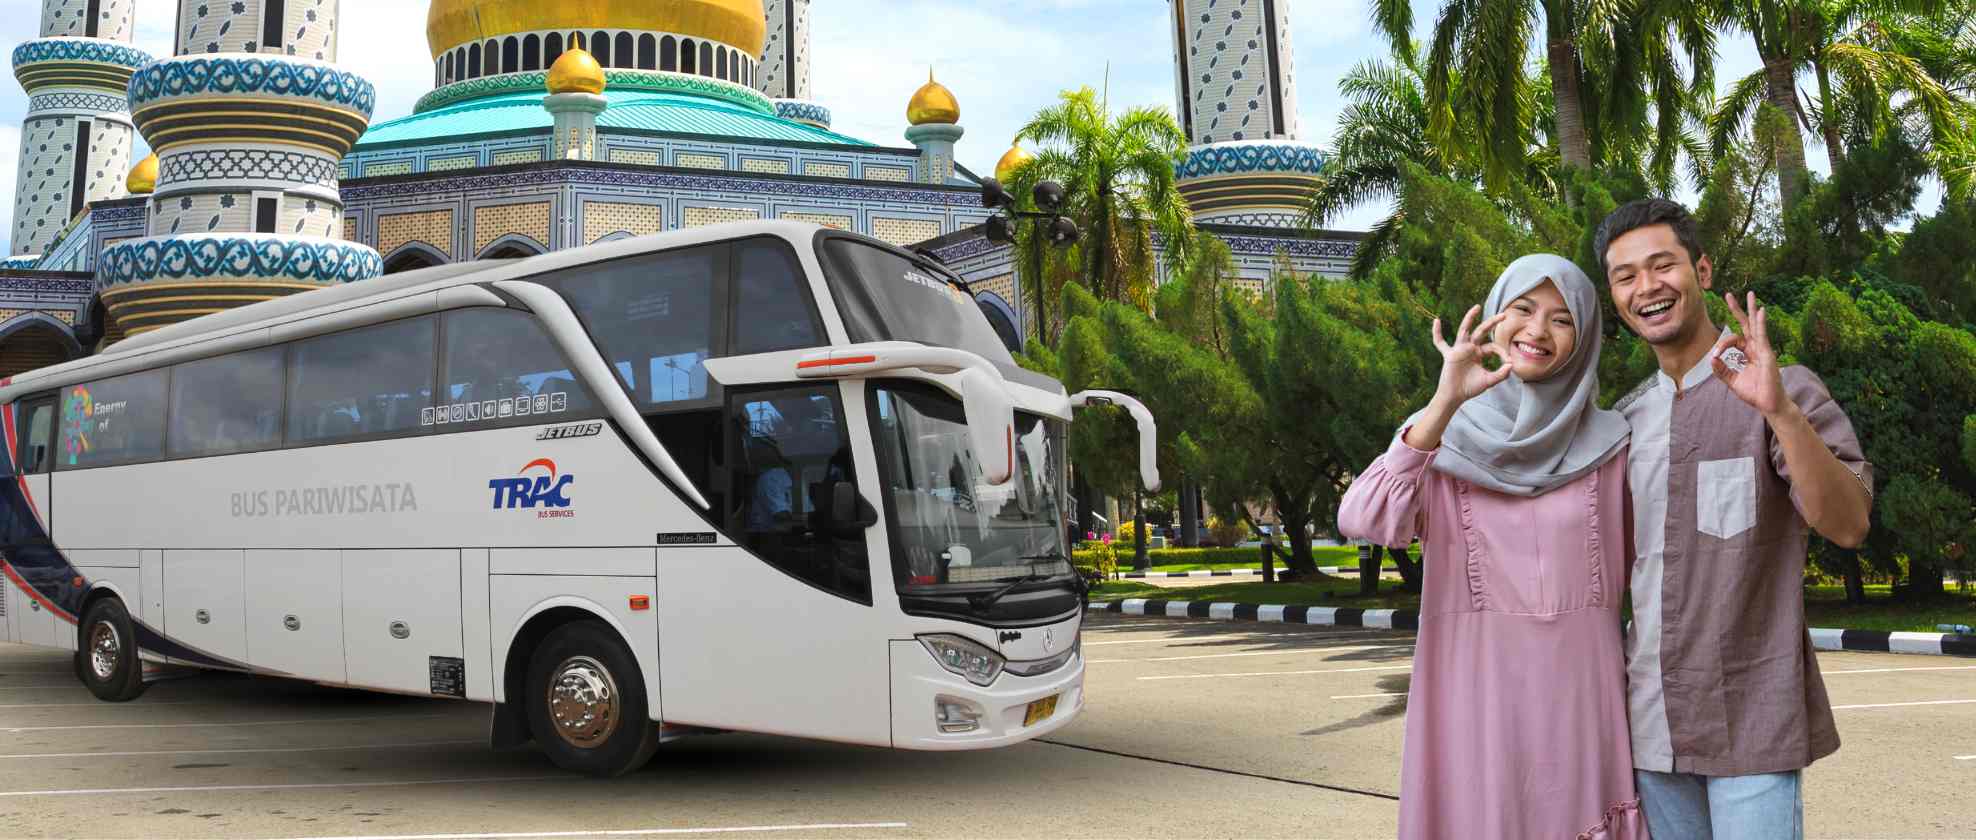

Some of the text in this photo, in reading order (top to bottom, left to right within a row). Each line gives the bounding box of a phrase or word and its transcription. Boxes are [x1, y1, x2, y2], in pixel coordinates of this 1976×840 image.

[98, 419, 110, 432] of
[536, 423, 602, 440] JETBUS
[488, 473, 574, 509] TRAC
[231, 482, 417, 518] BUS PARIWISATA
[537, 510, 574, 519] BUS SERVICES
[660, 534, 715, 544] Mercedes-Benz
